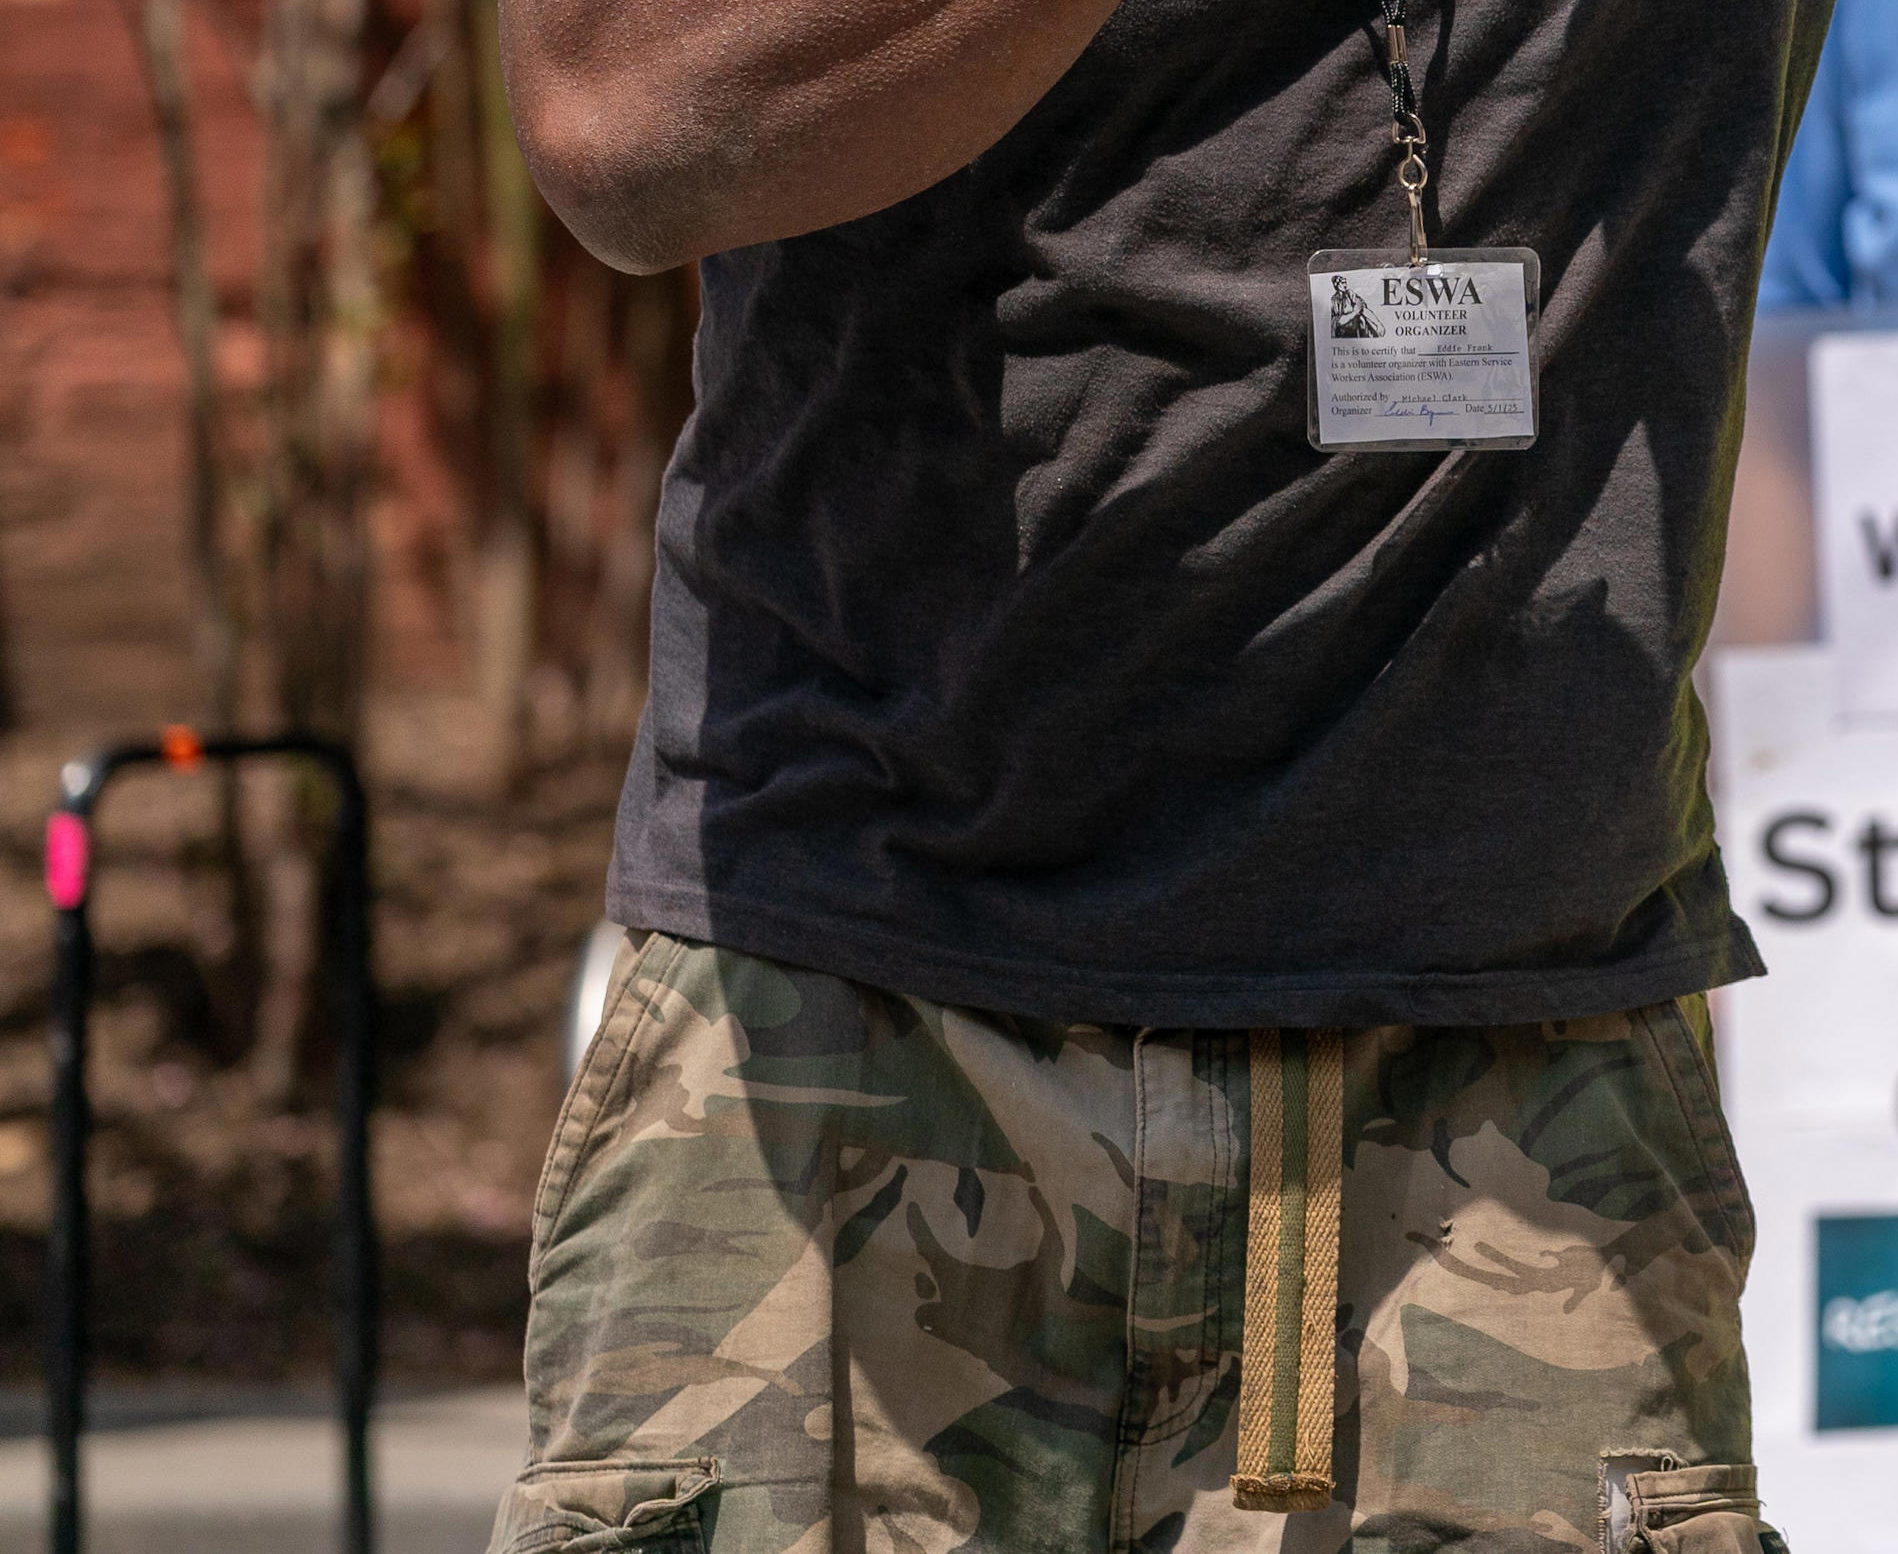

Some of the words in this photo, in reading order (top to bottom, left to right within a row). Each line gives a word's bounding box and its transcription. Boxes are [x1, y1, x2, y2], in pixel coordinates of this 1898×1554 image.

[1381, 277, 1483, 306] ESWA
[1395, 310, 1468, 321] VOLUNTEER
[1395, 325, 1467, 336] ORGANIZER
[1332, 347, 1350, 356] This
[1352, 347, 1360, 355] is
[1361, 347, 1370, 355] to
[1371, 346, 1398, 357] certify
[1401, 345, 1416, 355] that
[1331, 360, 1339, 369] is
[1347, 360, 1387, 368] volunteer
[1388, 360, 1427, 370] organizer
[1428, 358, 1447, 367] with
[1449, 358, 1480, 367] Eastern
[1481, 357, 1513, 366] Service
[1331, 373, 1366, 382] Workers
[1367, 373, 1416, 382] Association
[1417, 372, 1454, 382] (ESWA).
[1331, 392, 1377, 402] Authorized
[1380, 392, 1390, 403] by
[1331, 406, 1372, 417] Organizer
[1465, 404, 1485, 413] Date
